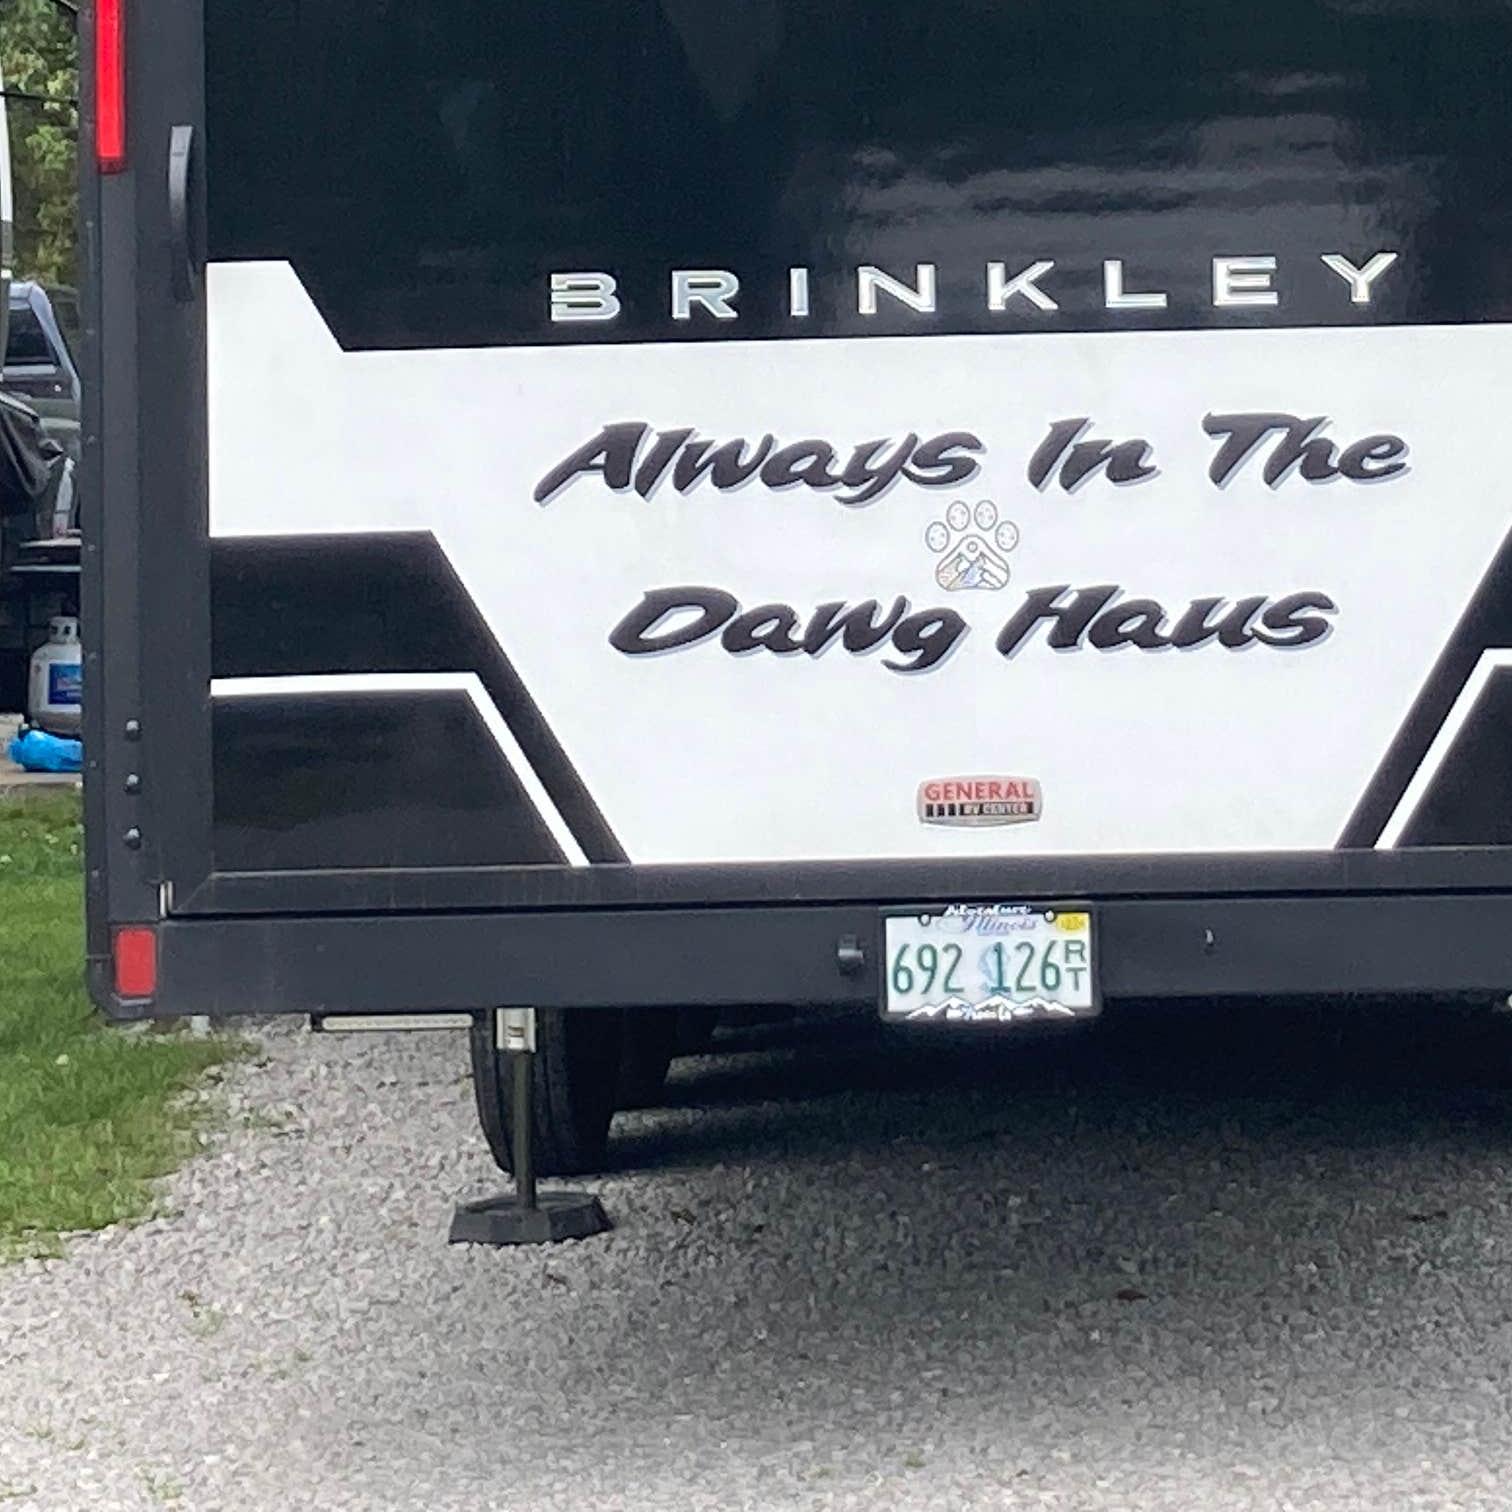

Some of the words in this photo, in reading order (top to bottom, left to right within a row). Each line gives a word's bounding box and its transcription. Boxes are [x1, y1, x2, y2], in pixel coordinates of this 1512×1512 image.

[549, 252, 1398, 322] BRINKLEY
[533, 418, 987, 507] Always
[1026, 415, 1162, 494] In
[1200, 410, 1413, 491] The
[607, 584, 974, 676] Dawg
[995, 583, 1341, 660] Haus
[924, 781, 1035, 801] GENERAL
[959, 915, 1038, 931] Illinois
[892, 943, 965, 995] 692
[990, 941, 1062, 992] 126
